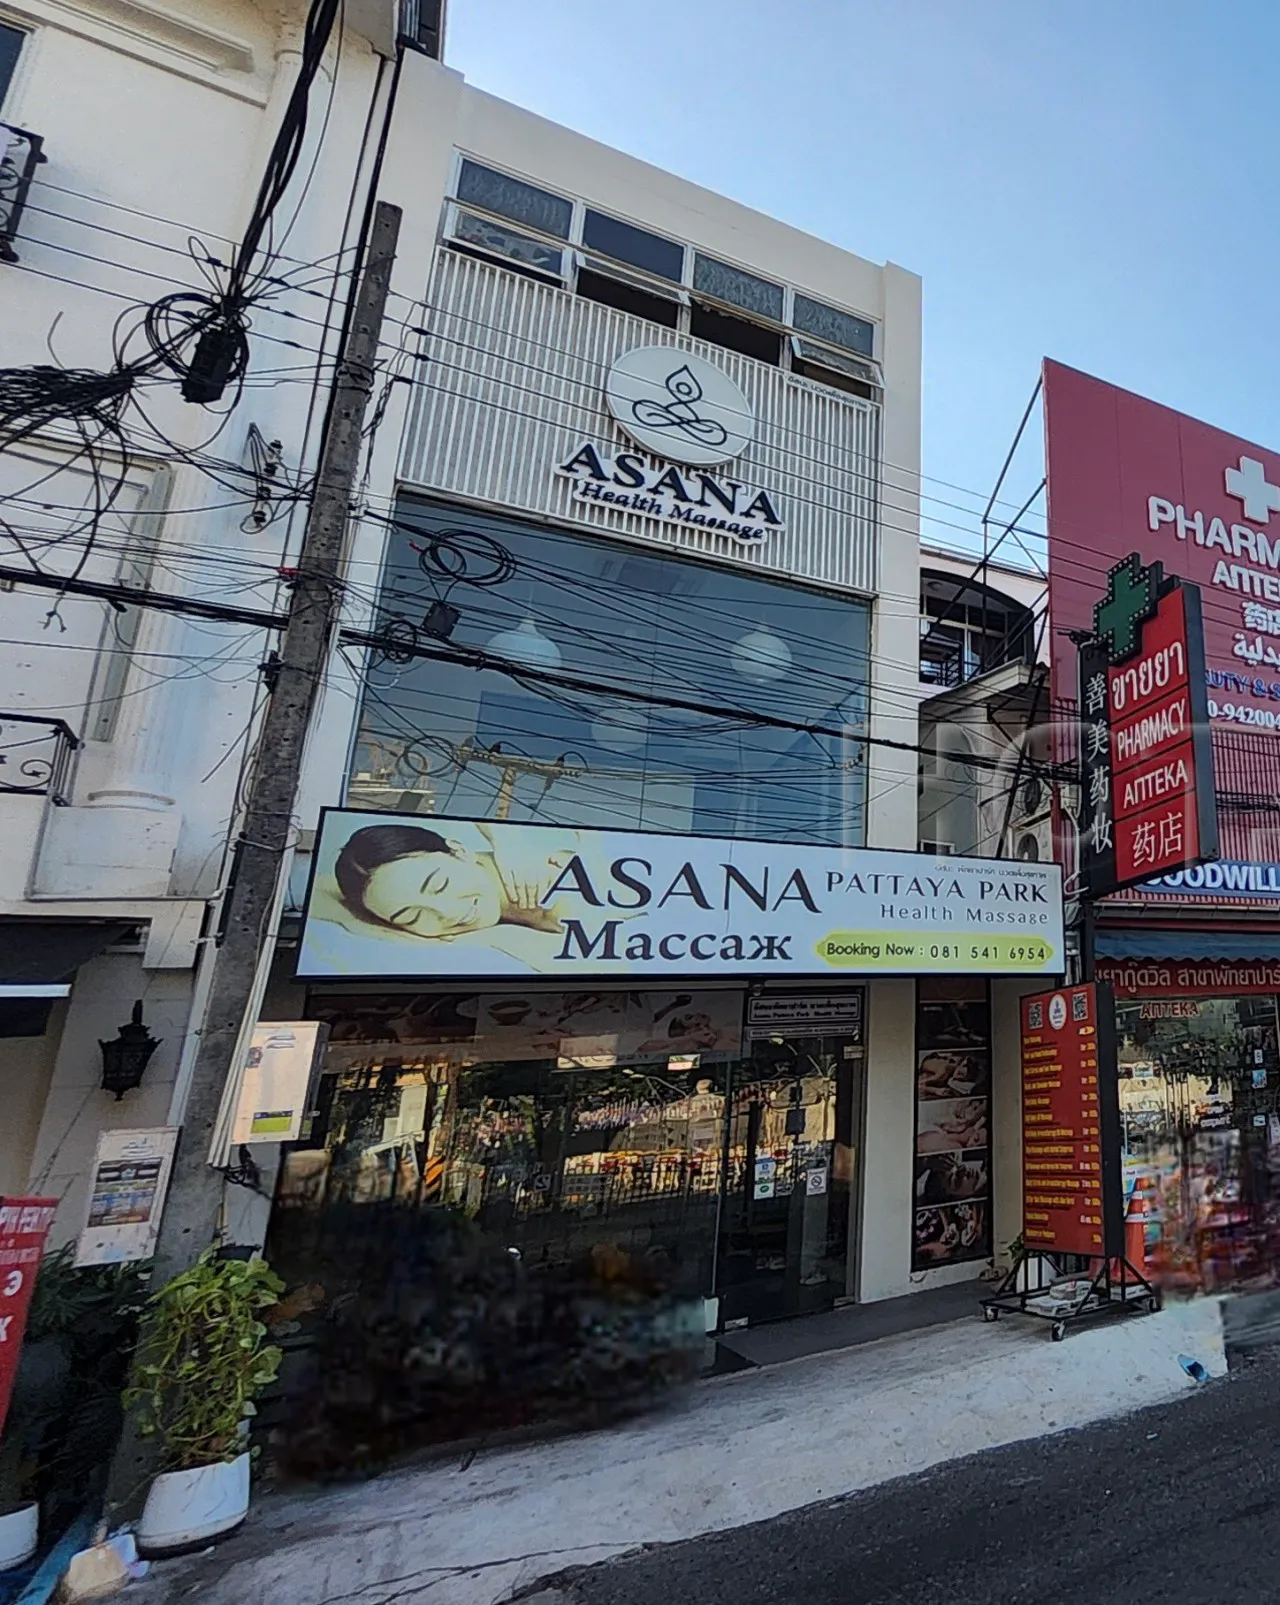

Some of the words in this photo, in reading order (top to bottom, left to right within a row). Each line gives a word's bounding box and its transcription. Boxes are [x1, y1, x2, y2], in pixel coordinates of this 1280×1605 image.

[561, 443, 783, 525] ASANA
[579, 480, 663, 516] Health
[668, 503, 764, 540] Massage
[1112, 641, 1185, 711] ขายยา
[1254, 679, 1267, 697] &
[1116, 698, 1187, 761] PHARMACY
[1123, 759, 1189, 810] АПТЕКА
[1131, 811, 1184, 869] 药店
[540, 855, 822, 914] ASANA
[826, 870, 966, 900] PATTAYA
[979, 881, 1049, 903] PARK
[553, 919, 793, 961] Массаж
[880, 904, 954, 921] Health
[966, 908, 1049, 925] Massage
[826, 942, 881, 959] Booking
[885, 944, 915, 957] Now
[930, 945, 960, 959] 081
[971, 946, 999, 959] 541
[1009, 947, 1046, 960] 6954
[1139, 1000, 1200, 1019] АПТЕКА
